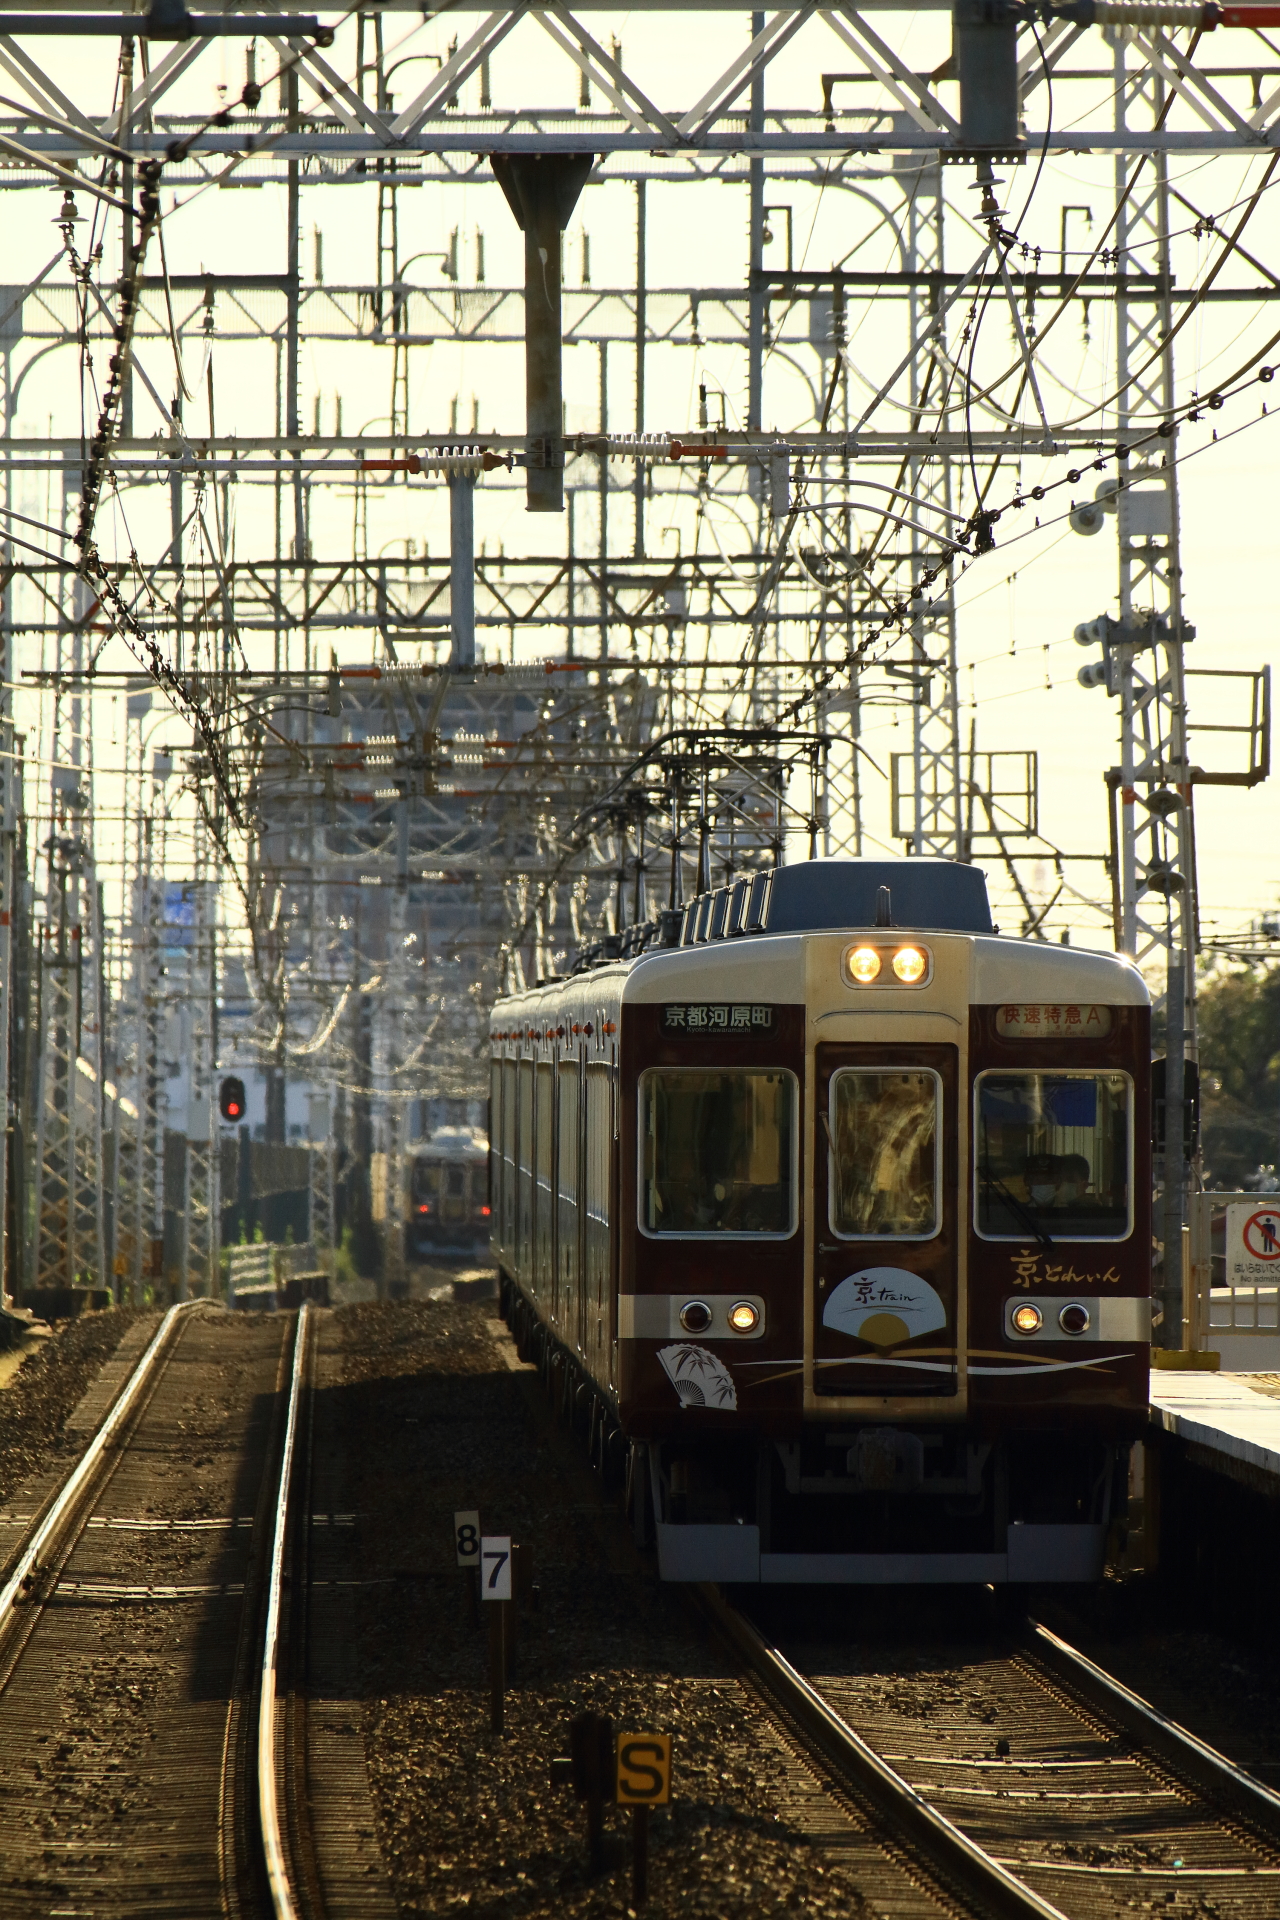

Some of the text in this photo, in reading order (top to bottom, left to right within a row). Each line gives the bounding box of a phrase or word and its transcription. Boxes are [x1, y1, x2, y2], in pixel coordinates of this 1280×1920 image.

[665, 1005, 773, 1027] 京都河原町
[1003, 1006, 1101, 1024] 快速特急A
[1010, 1249, 1121, 1288] 京とれいん
[457, 1524, 479, 1556] 8
[483, 1552, 509, 1589] 7
[619, 1742, 664, 1799] S
